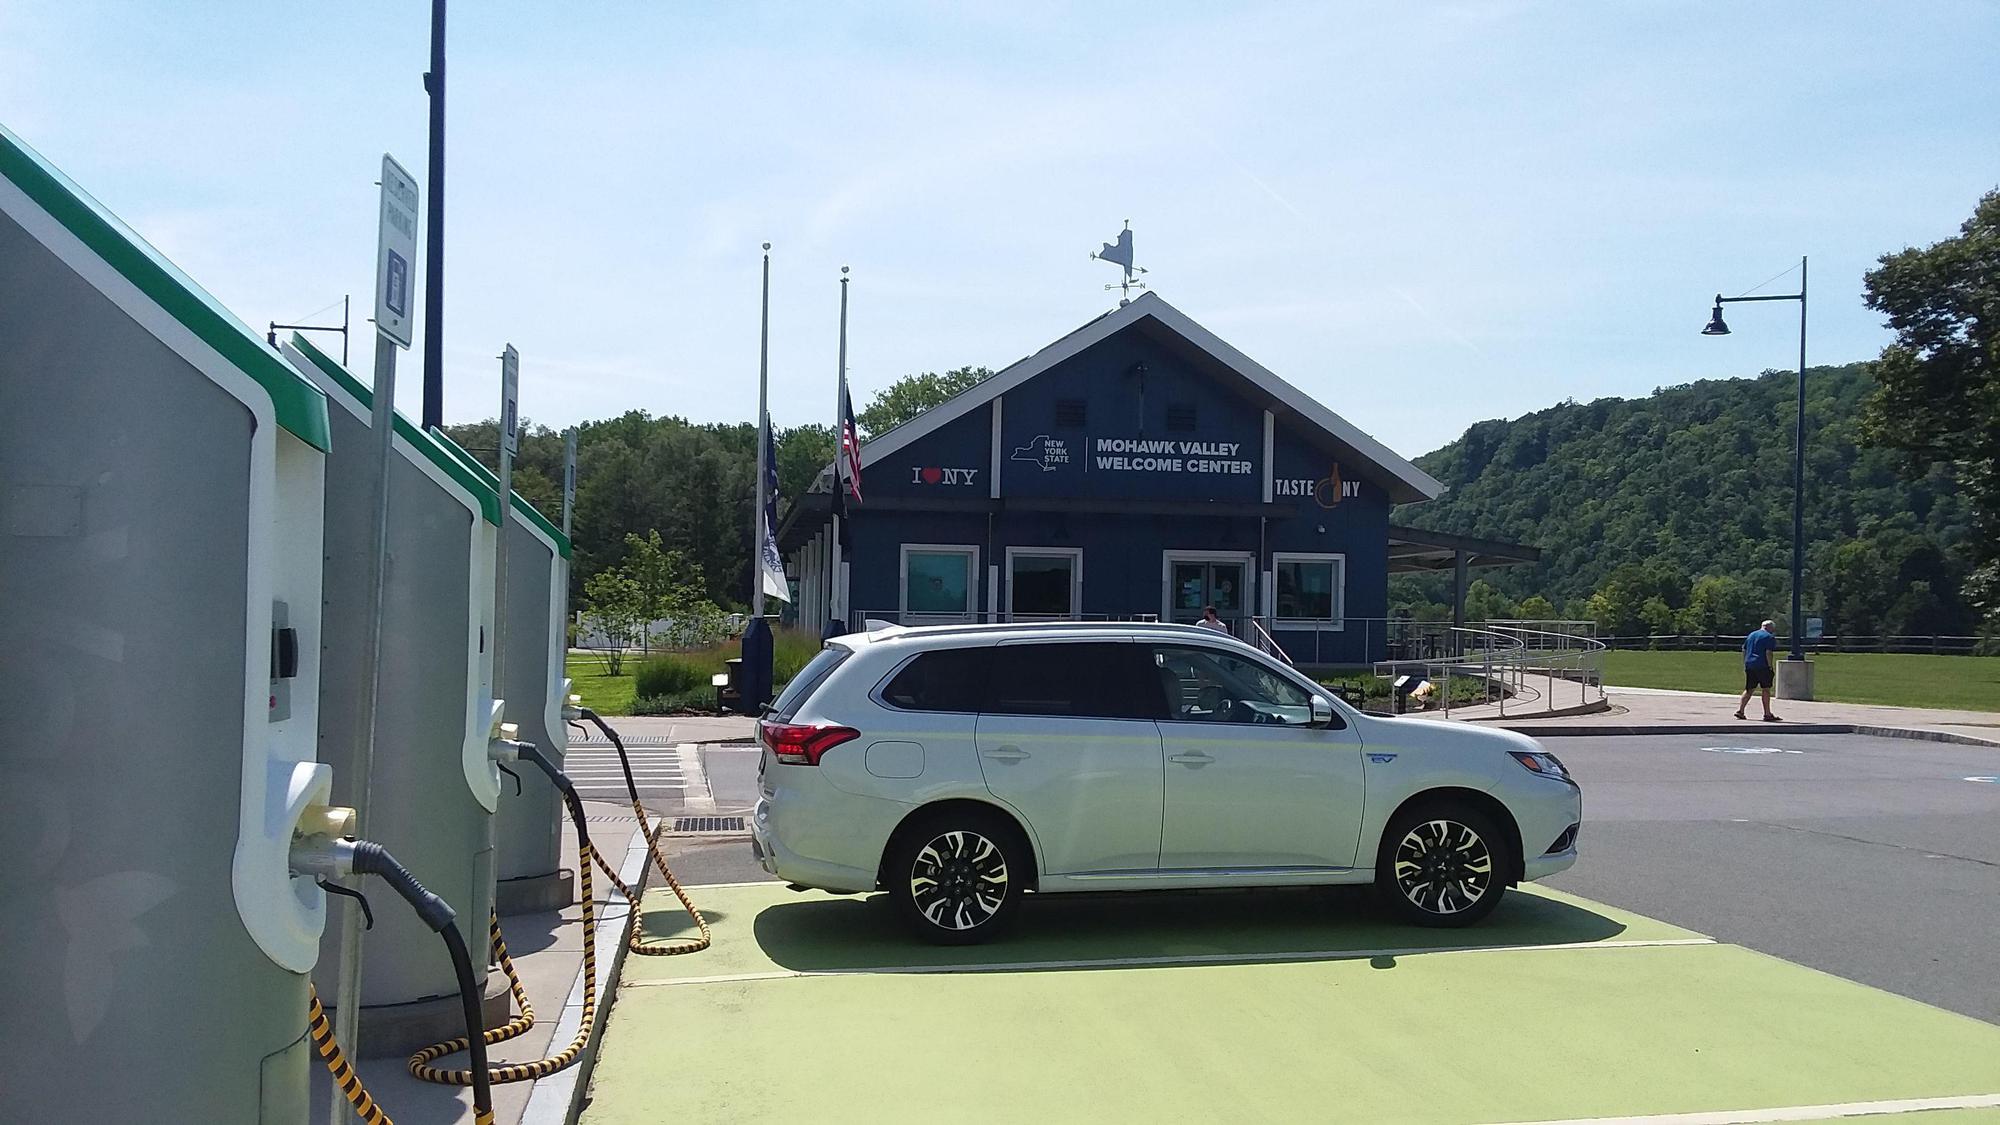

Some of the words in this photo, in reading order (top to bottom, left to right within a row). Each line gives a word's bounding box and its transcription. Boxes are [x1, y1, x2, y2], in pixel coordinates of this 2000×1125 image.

[1044, 447, 1067, 455] YORK
[1097, 439, 1176, 454] MOHAWK
[1179, 441, 1240, 456] VALLEY
[1044, 455, 1069, 463] STATE
[1096, 456, 1182, 471] WELCOME
[1186, 459, 1252, 474] CENTER
[912, 467, 922, 484] I
[942, 468, 978, 485] NY
[1275, 479, 1314, 496] TASTE
[1342, 481, 1360, 497] NY
